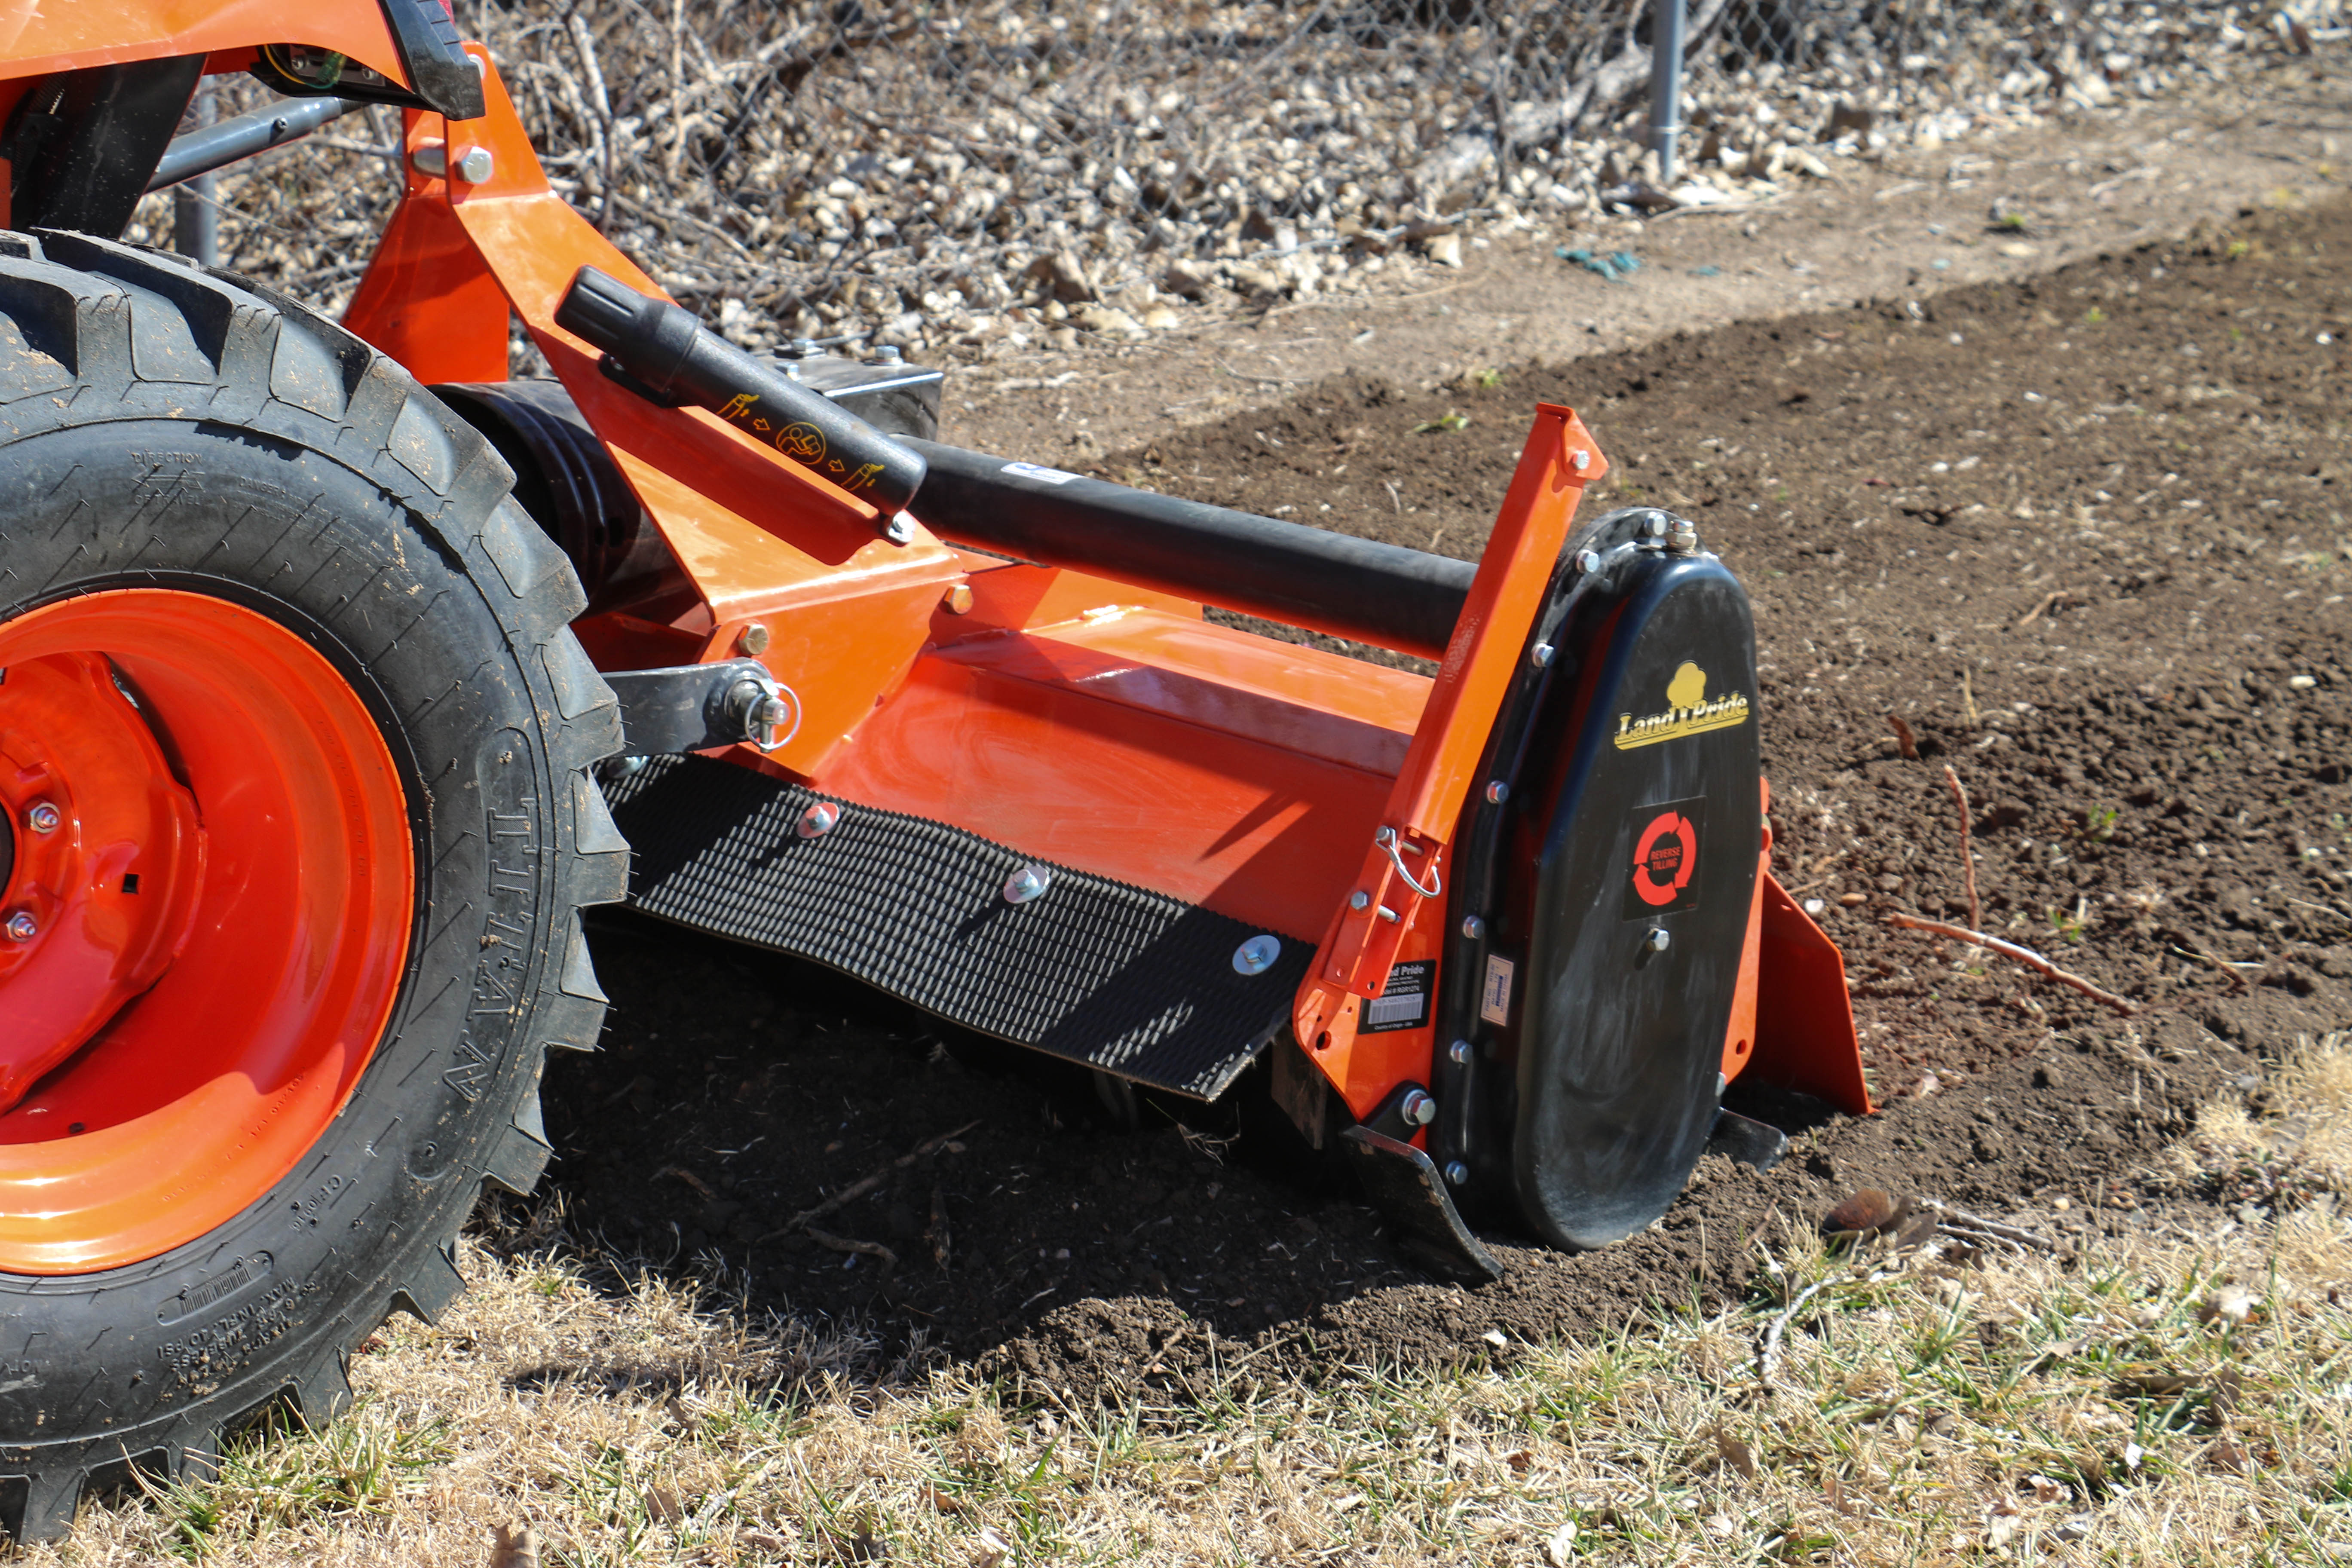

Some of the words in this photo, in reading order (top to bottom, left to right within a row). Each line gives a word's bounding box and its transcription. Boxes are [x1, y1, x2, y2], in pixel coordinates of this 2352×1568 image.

[130, 450, 204, 466] DIRECTION
[1615, 705, 1678, 741] Land
[1687, 690, 1749, 727] Pride
[1650, 846, 1681, 861] REVERSE
[1652, 858, 1678, 871] TILLING
[442, 797, 538, 1101] TITAN
[1401, 965, 1425, 976] Pride
[157, 1338, 184, 1359] PSI
